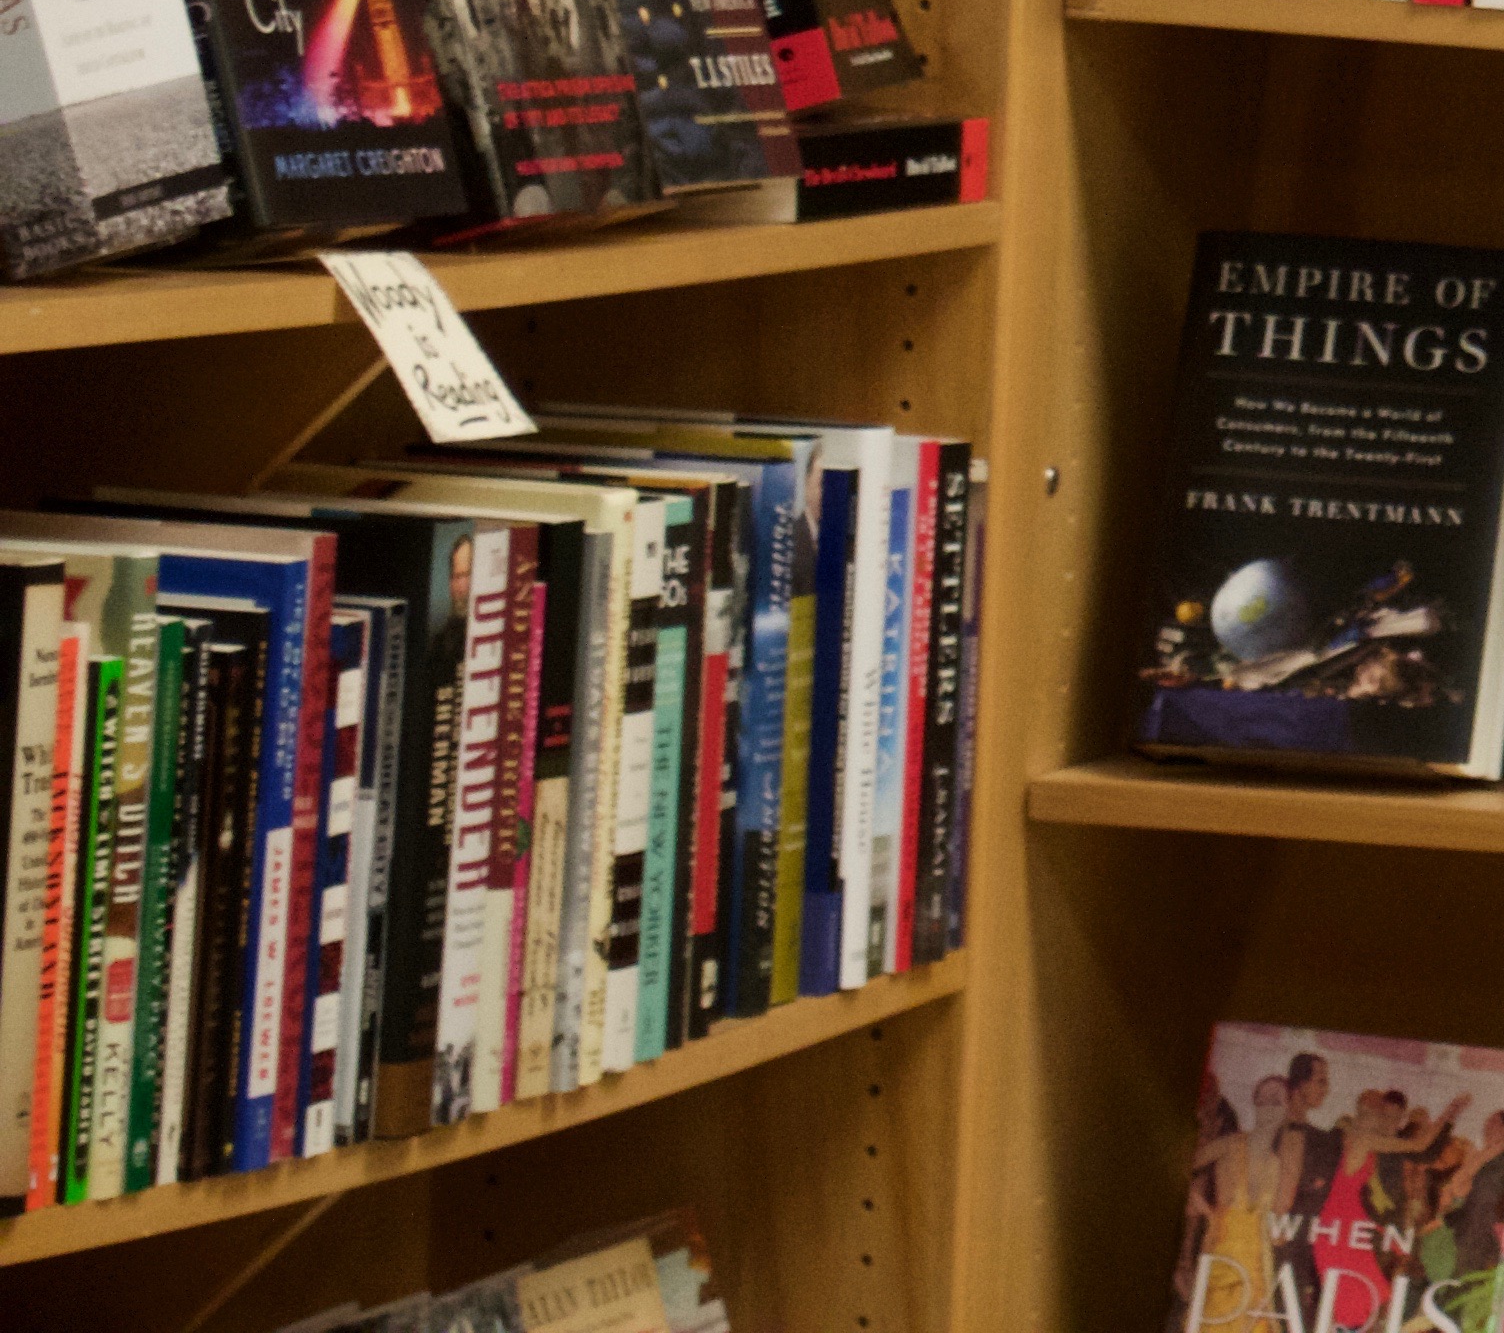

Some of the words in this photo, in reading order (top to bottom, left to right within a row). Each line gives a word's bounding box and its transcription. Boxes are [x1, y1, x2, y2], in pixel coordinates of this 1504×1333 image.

[1217, 261, 1410, 307] EMPIRE
[1434, 277, 1496, 311] OF
[1207, 311, 1490, 374] THINGS
[413, 361, 511, 425] Reading
[1185, 489, 1280, 518] FRANK
[1288, 496, 1465, 529] TRENTMANN
[1269, 1212, 1416, 1253] WHEN
